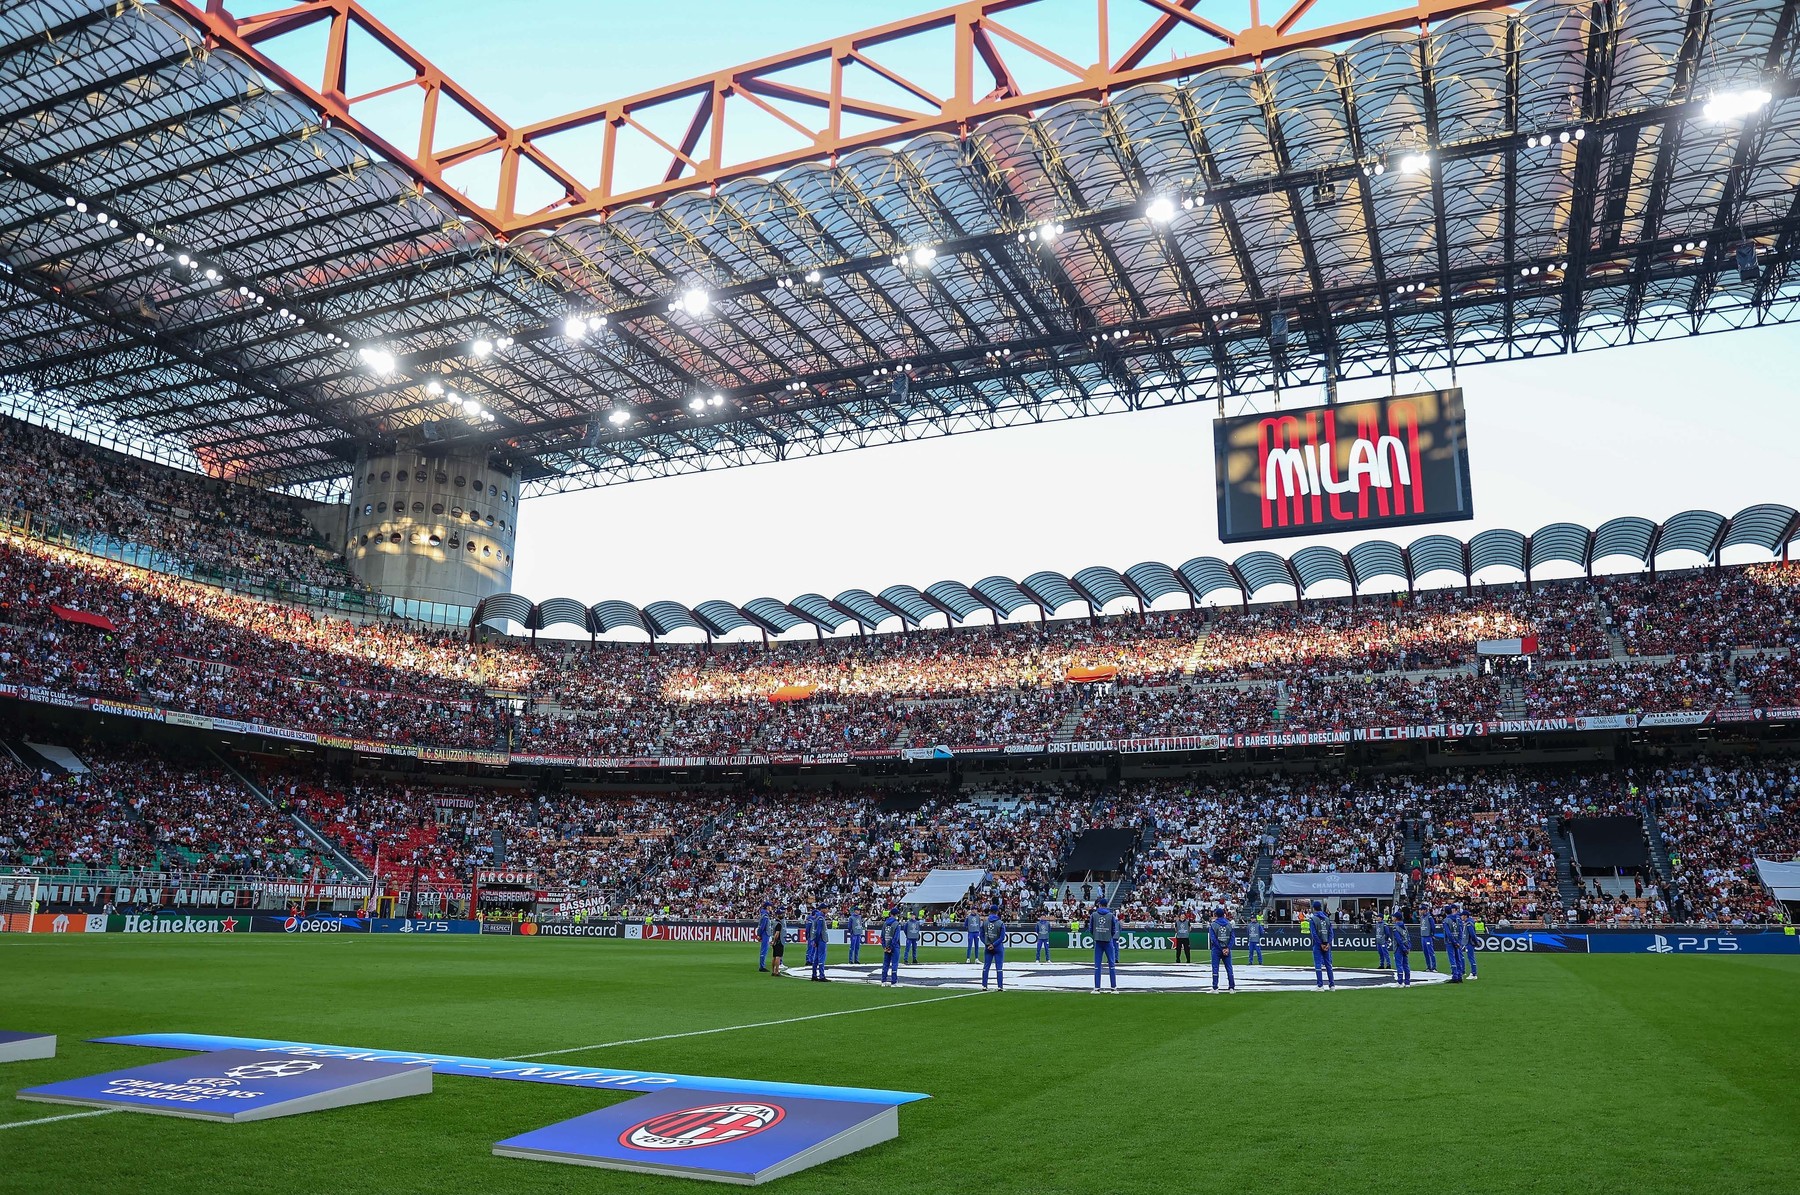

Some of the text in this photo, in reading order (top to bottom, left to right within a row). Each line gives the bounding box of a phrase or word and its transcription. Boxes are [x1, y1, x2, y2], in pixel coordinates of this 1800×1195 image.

[1266, 435, 1411, 500] MILAN
[29, 687, 66, 699] MILAN CLUB
[92, 703, 122, 715] CRANS
[123, 708, 164, 722] MONTANA
[101, 699, 153, 712] MILAN CLUB
[1500, 718, 1568, 732] DESENZANO
[257, 725, 316, 742] MILAN CLUB ISCHIA
[1237, 737, 1244, 747] F.
[1245, 735, 1271, 746] BARESI
[1272, 733, 1307, 745] BASSANO
[1308, 731, 1350, 743] BRESCIANO
[353, 744, 369, 752] SANTA
[1120, 737, 1201, 753] CASTELFIDARDO
[434, 749, 463, 761] SALUZZO
[709, 756, 728, 766] MILAN
[729, 756, 747, 766] CLUB
[748, 755, 769, 765] LATINA
[441, 799, 474, 809] VIPITENO
[479, 872, 533, 884] ARCORE
[0, 885, 235, 905] FAMILY DAY AIMC
[499, 891, 530, 902] SEREGNO
[560, 896, 605, 912] BASSANO
[123, 915, 219, 933] Heineken
[300, 917, 342, 933] pepsi
[416, 921, 448, 932] PS5
[541, 923, 617, 936] mastercard
[667, 926, 759, 943] TURKISH AIRLINES
[918, 932, 963, 947] ppo
[1067, 932, 1167, 949] Heeken
[1260, 937, 1312, 948] CHAMPIO
[1331, 937, 1376, 948] LEAGUE
[1677, 937, 1738, 951] PS5
[101, 1087, 212, 1102] LEAGUE
[109, 1079, 264, 1099] CHAMPIONS
[706, 1105, 771, 1118] ACM
[636, 1135, 693, 1146] 1899
